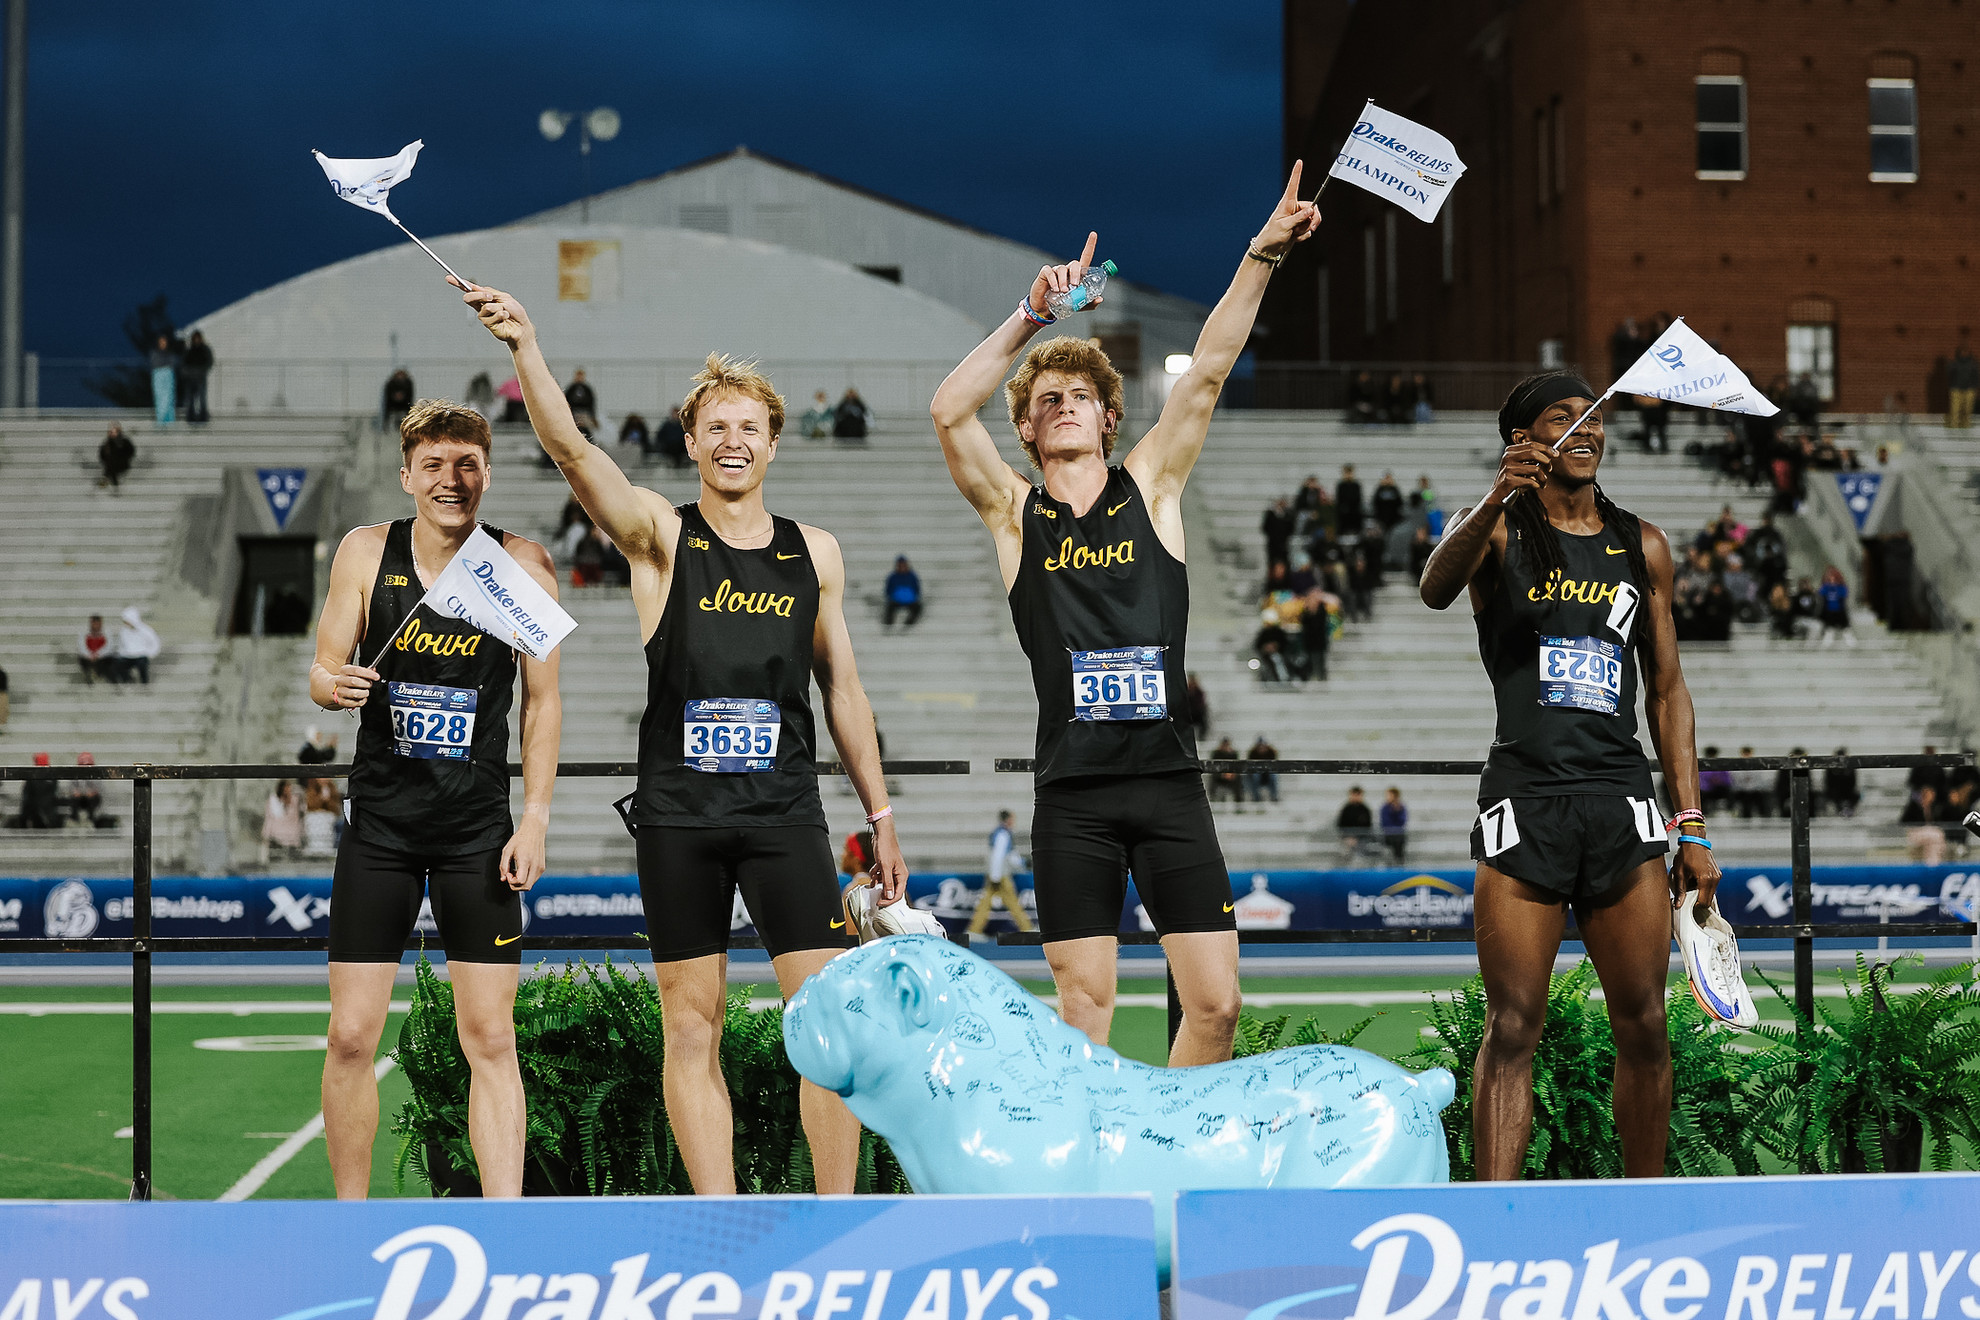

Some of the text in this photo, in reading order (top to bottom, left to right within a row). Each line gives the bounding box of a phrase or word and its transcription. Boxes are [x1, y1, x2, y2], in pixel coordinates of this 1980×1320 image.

[1352, 121, 1452, 173] Drake RELAYS
[1336, 153, 1430, 204] CHAMPION
[1044, 536, 1135, 571] Iowa
[473, 560, 514, 609] Drake
[509, 606, 549, 644] RELAYS
[698, 578, 796, 618] Iowa
[1616, 587, 1639, 630] 7
[395, 617, 483, 657] Iowa
[1080, 673, 1159, 704] 3615
[1547, 649, 1618, 689] 3623
[393, 709, 467, 744] 3628
[690, 725, 772, 755] 3635
[1486, 804, 1506, 851] 7
[104, 896, 245, 923] @DBulldogs
[372, 1224, 742, 1320] Drake
[1350, 1212, 1711, 1320] Drake
